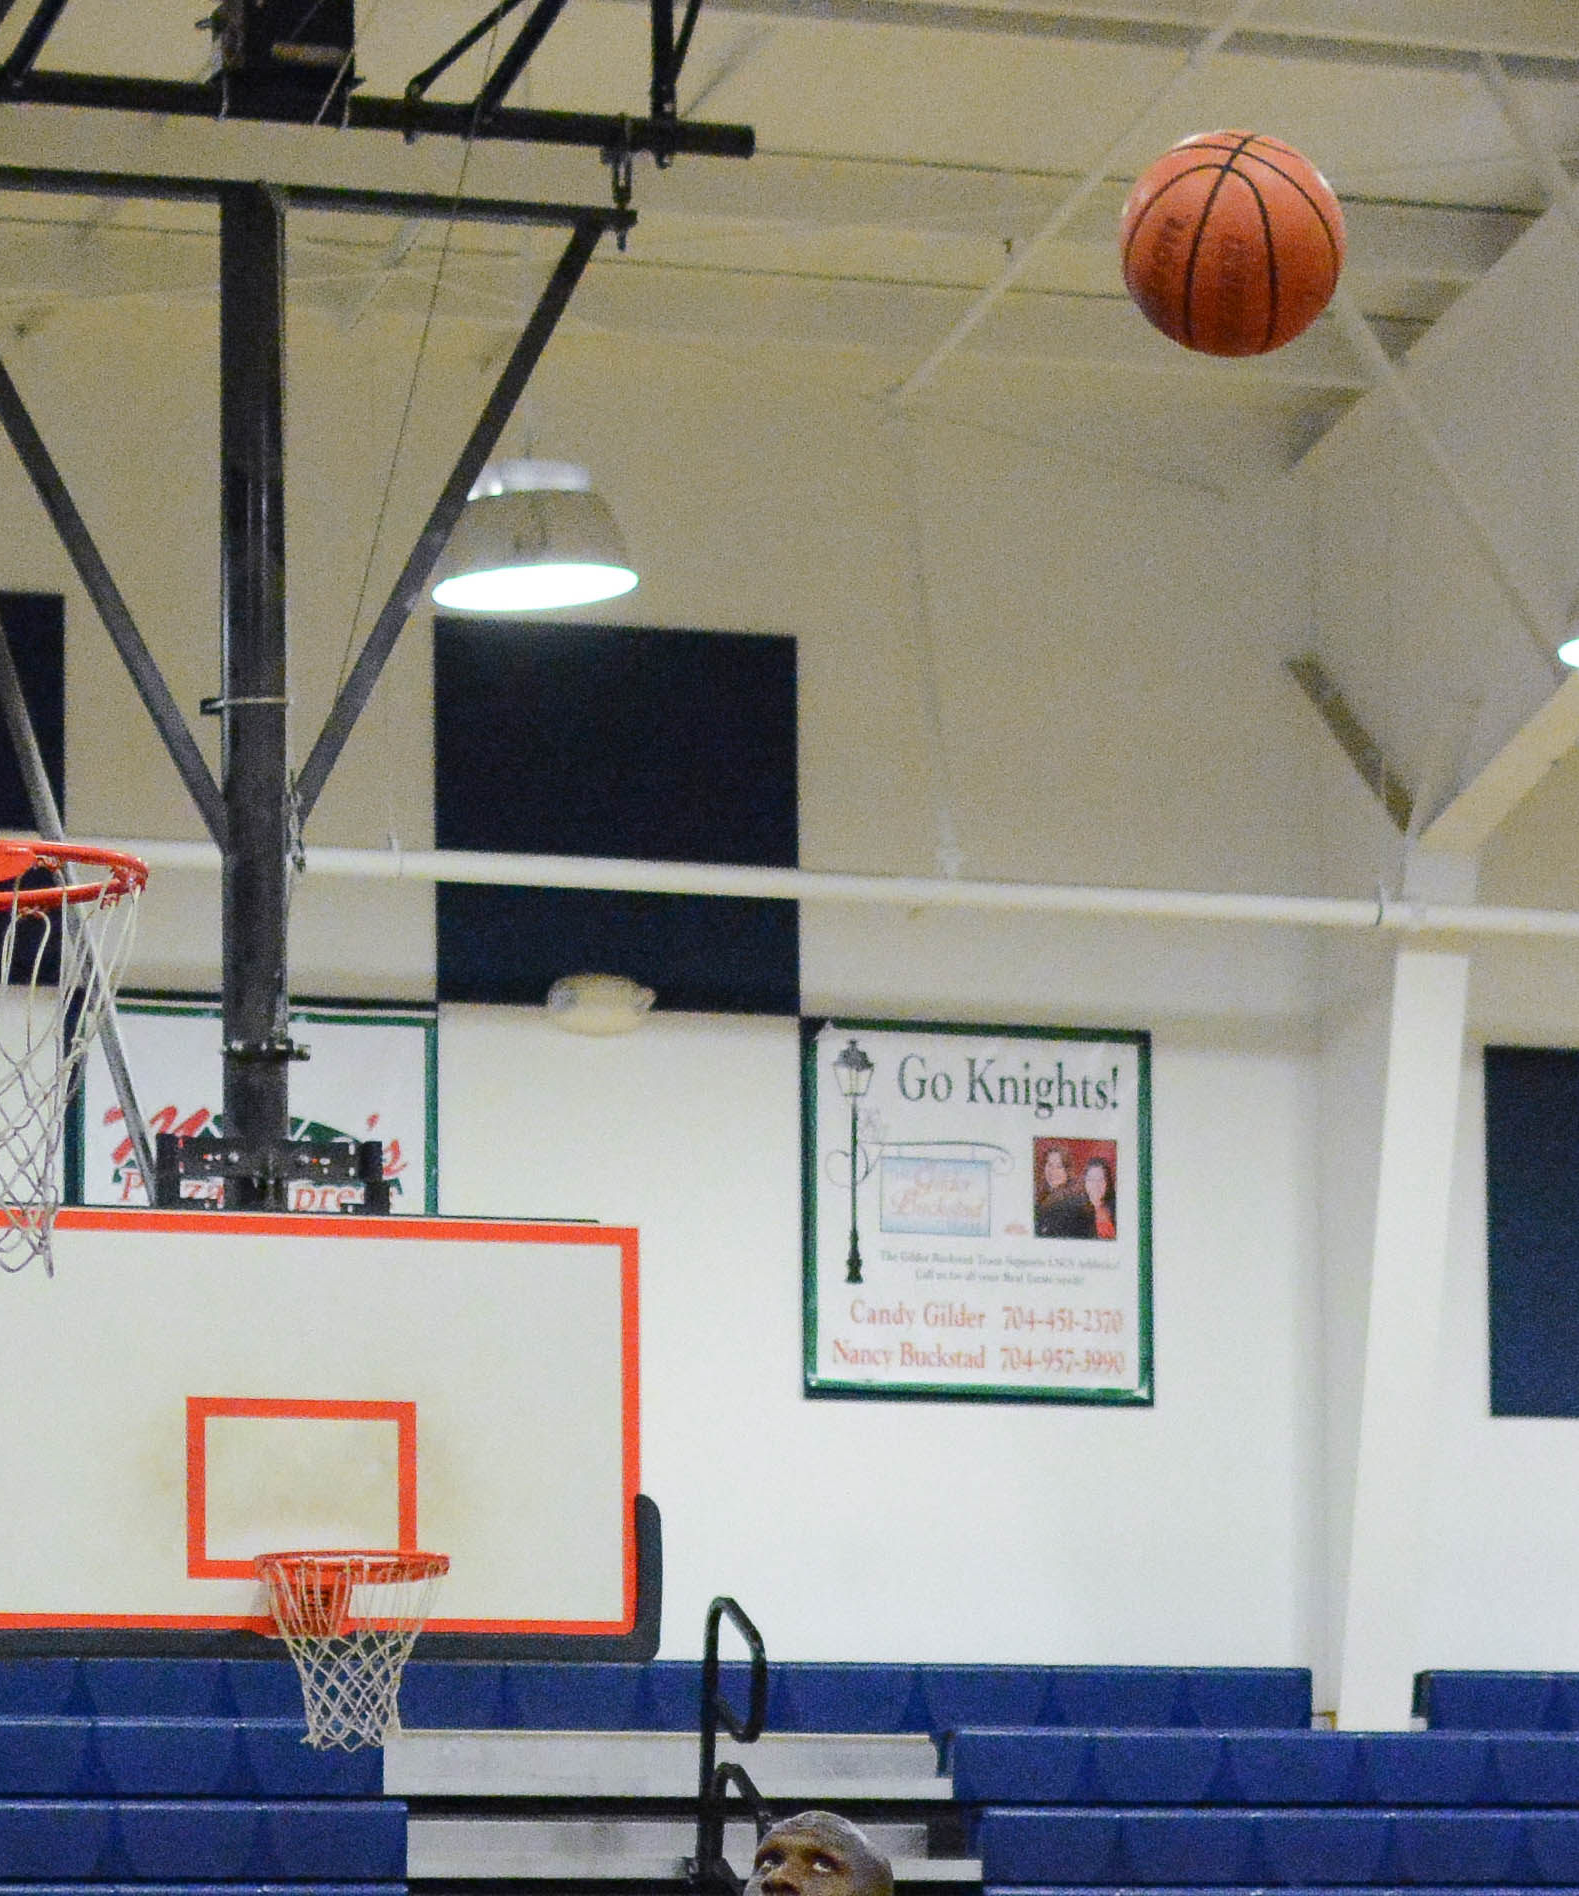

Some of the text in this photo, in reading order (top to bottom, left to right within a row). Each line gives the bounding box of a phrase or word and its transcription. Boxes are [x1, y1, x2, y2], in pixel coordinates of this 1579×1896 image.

[897, 1052, 1120, 1120] Go Knights!
[849, 1298, 916, 1329] Candy
[922, 1300, 986, 1330] Gilder
[831, 1338, 894, 1370] Nancy
[899, 1340, 986, 1370] Buckstad
